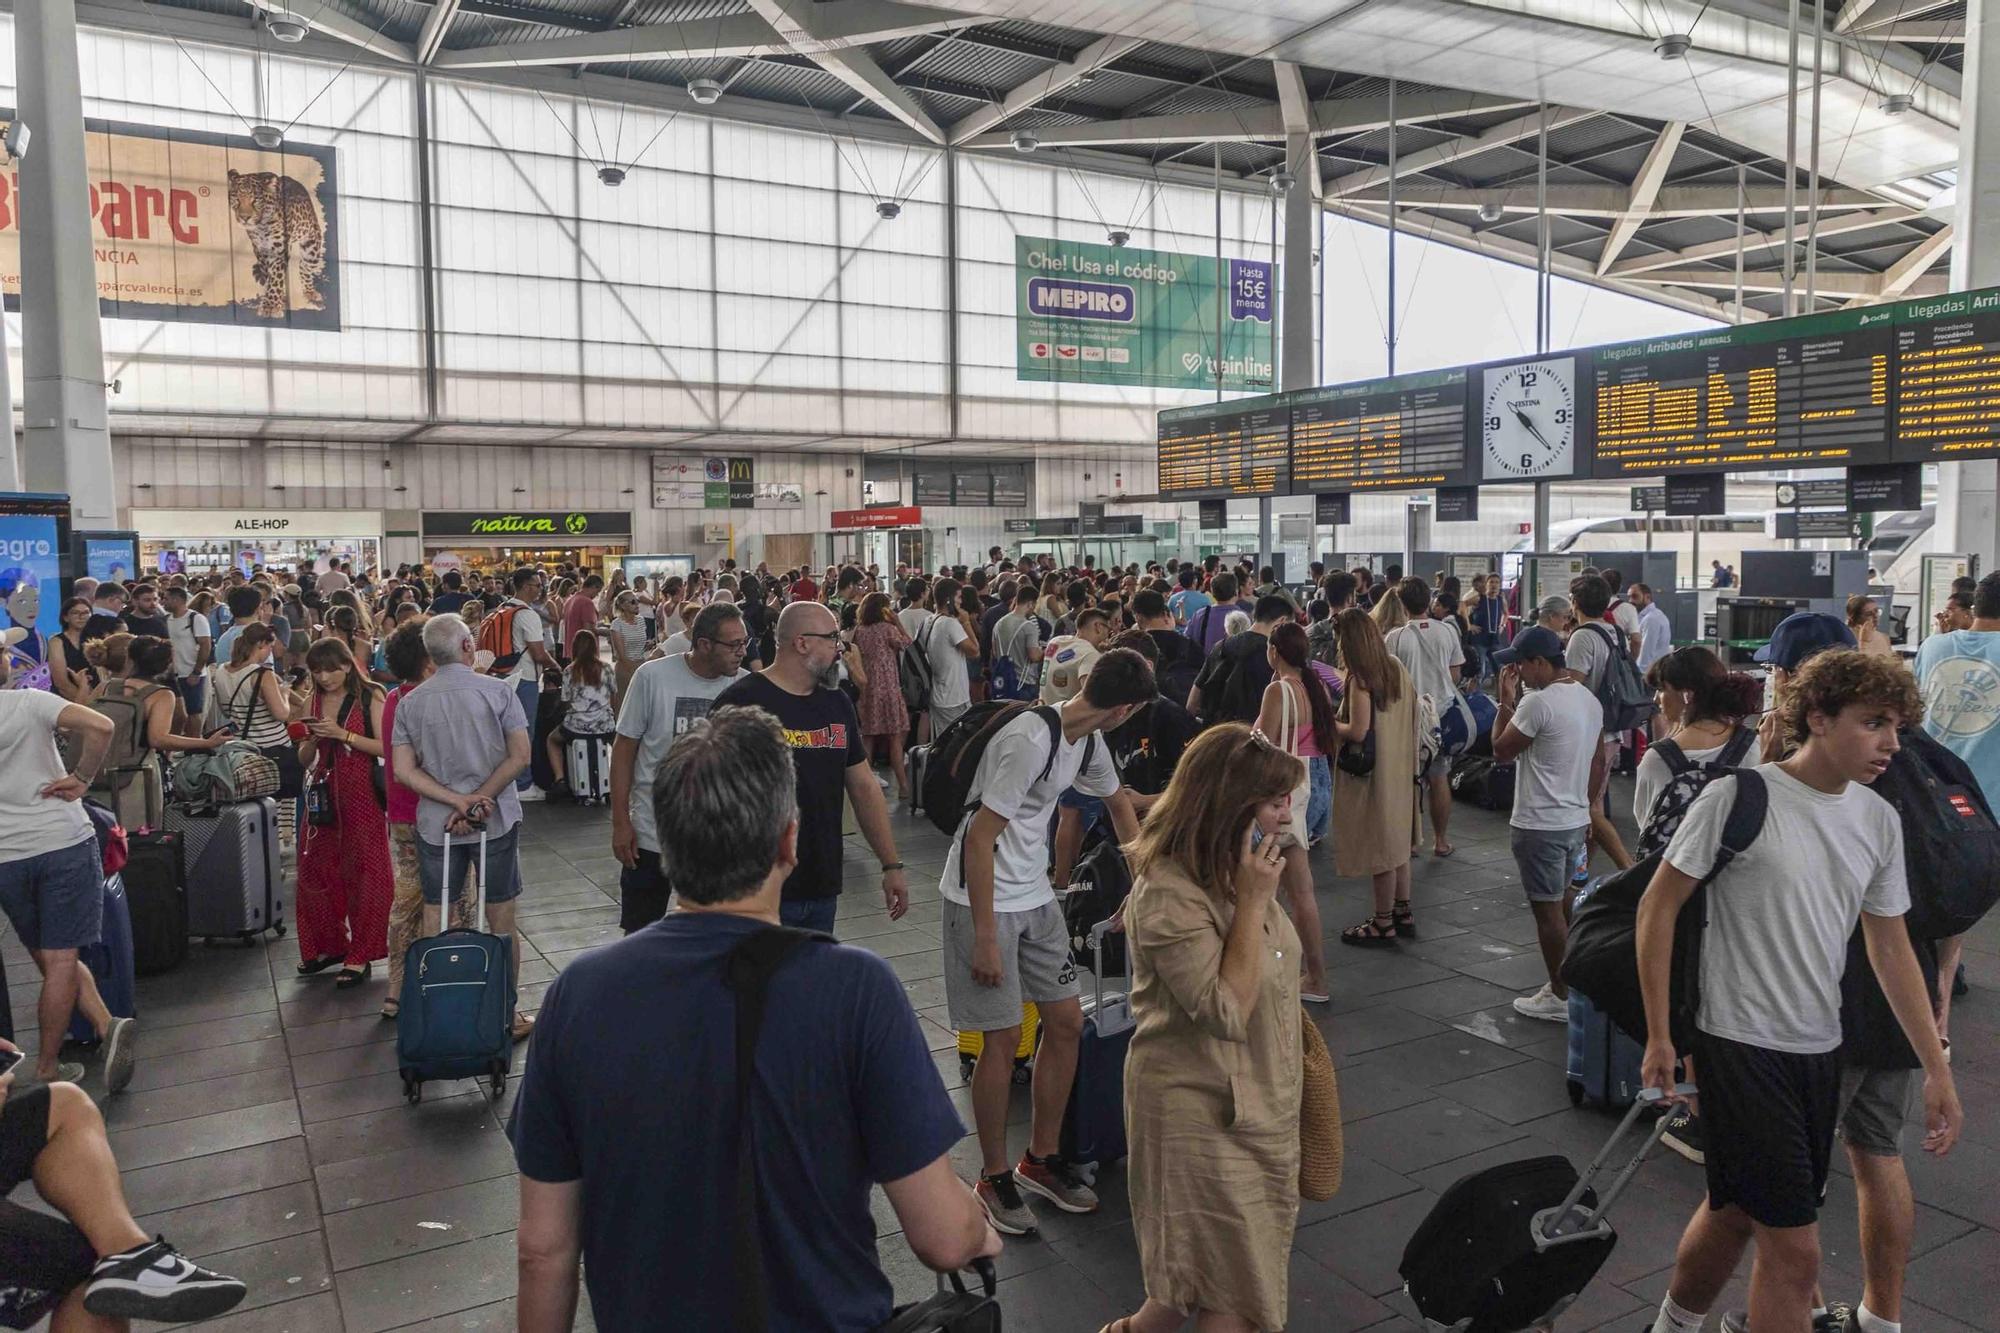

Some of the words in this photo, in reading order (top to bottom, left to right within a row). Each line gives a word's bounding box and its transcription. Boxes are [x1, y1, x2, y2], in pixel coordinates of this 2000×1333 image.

[1027, 251, 1067, 271] Che!
[1072, 255, 1101, 274] Usa
[1105, 259, 1119, 276] el
[1123, 262, 1177, 285] código
[1239, 266, 1264, 279] Hasta
[1236, 279, 1266, 299] 15€
[1037, 286, 1127, 313] MEPIRO
[1236, 298, 1265, 309] menos
[1908, 300, 1965, 318] Llegadas
[1972, 291, 2000, 309] Arri
[1603, 346, 1642, 360] Llegadas
[1647, 339, 1694, 354] Arribades
[1519, 372, 1537, 388] 12
[1490, 417, 1501, 430] 9
[1555, 409, 1566, 424] 3
[1521, 454, 1532, 468] 6
[1636, 499, 1643, 509] 5
[234, 519, 289, 529] ALE-HOP
[471, 515, 557, 533] natura
